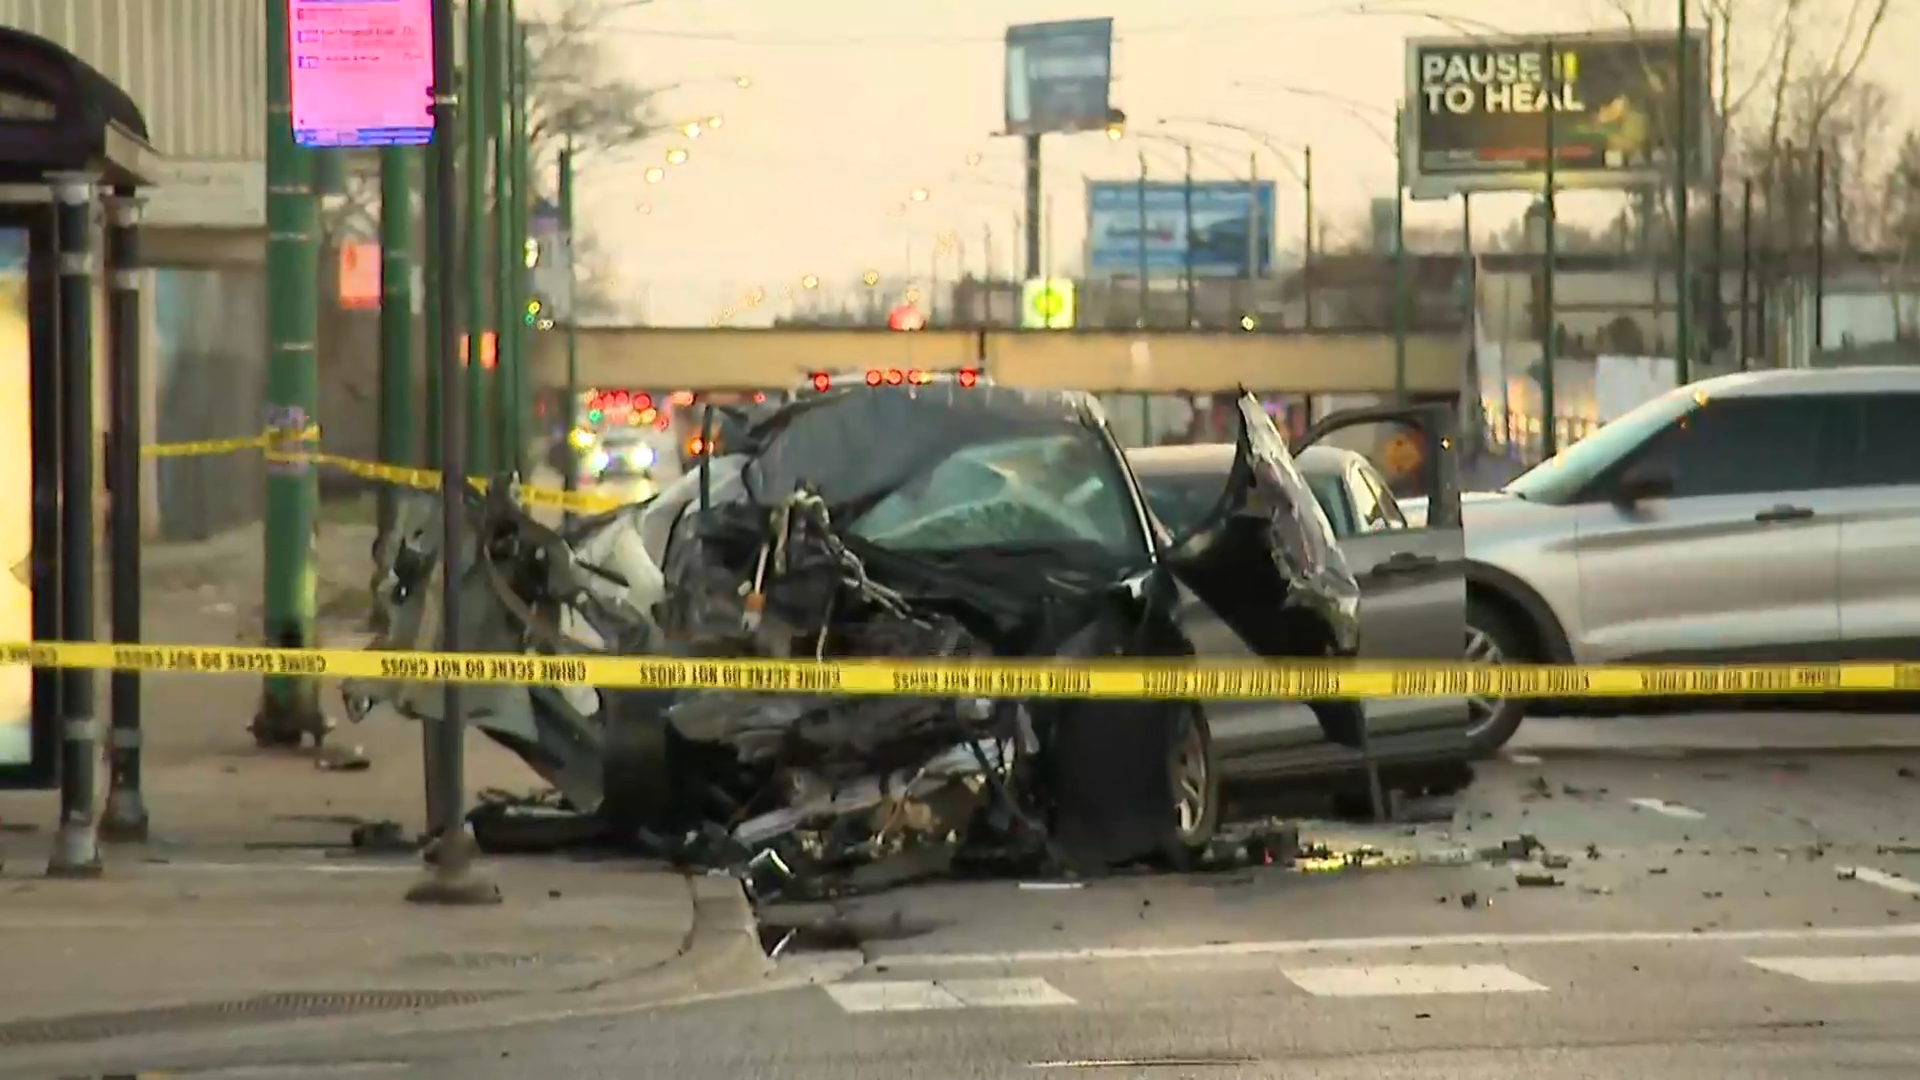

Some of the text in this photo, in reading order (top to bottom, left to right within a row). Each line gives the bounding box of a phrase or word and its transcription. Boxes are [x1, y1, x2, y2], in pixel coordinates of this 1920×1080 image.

[1422, 51, 1541, 84] PAUSE
[1423, 83, 1585, 114] TO HEAL
[380, 657, 586, 682] CRIME SCENE DO NOT CROSS
